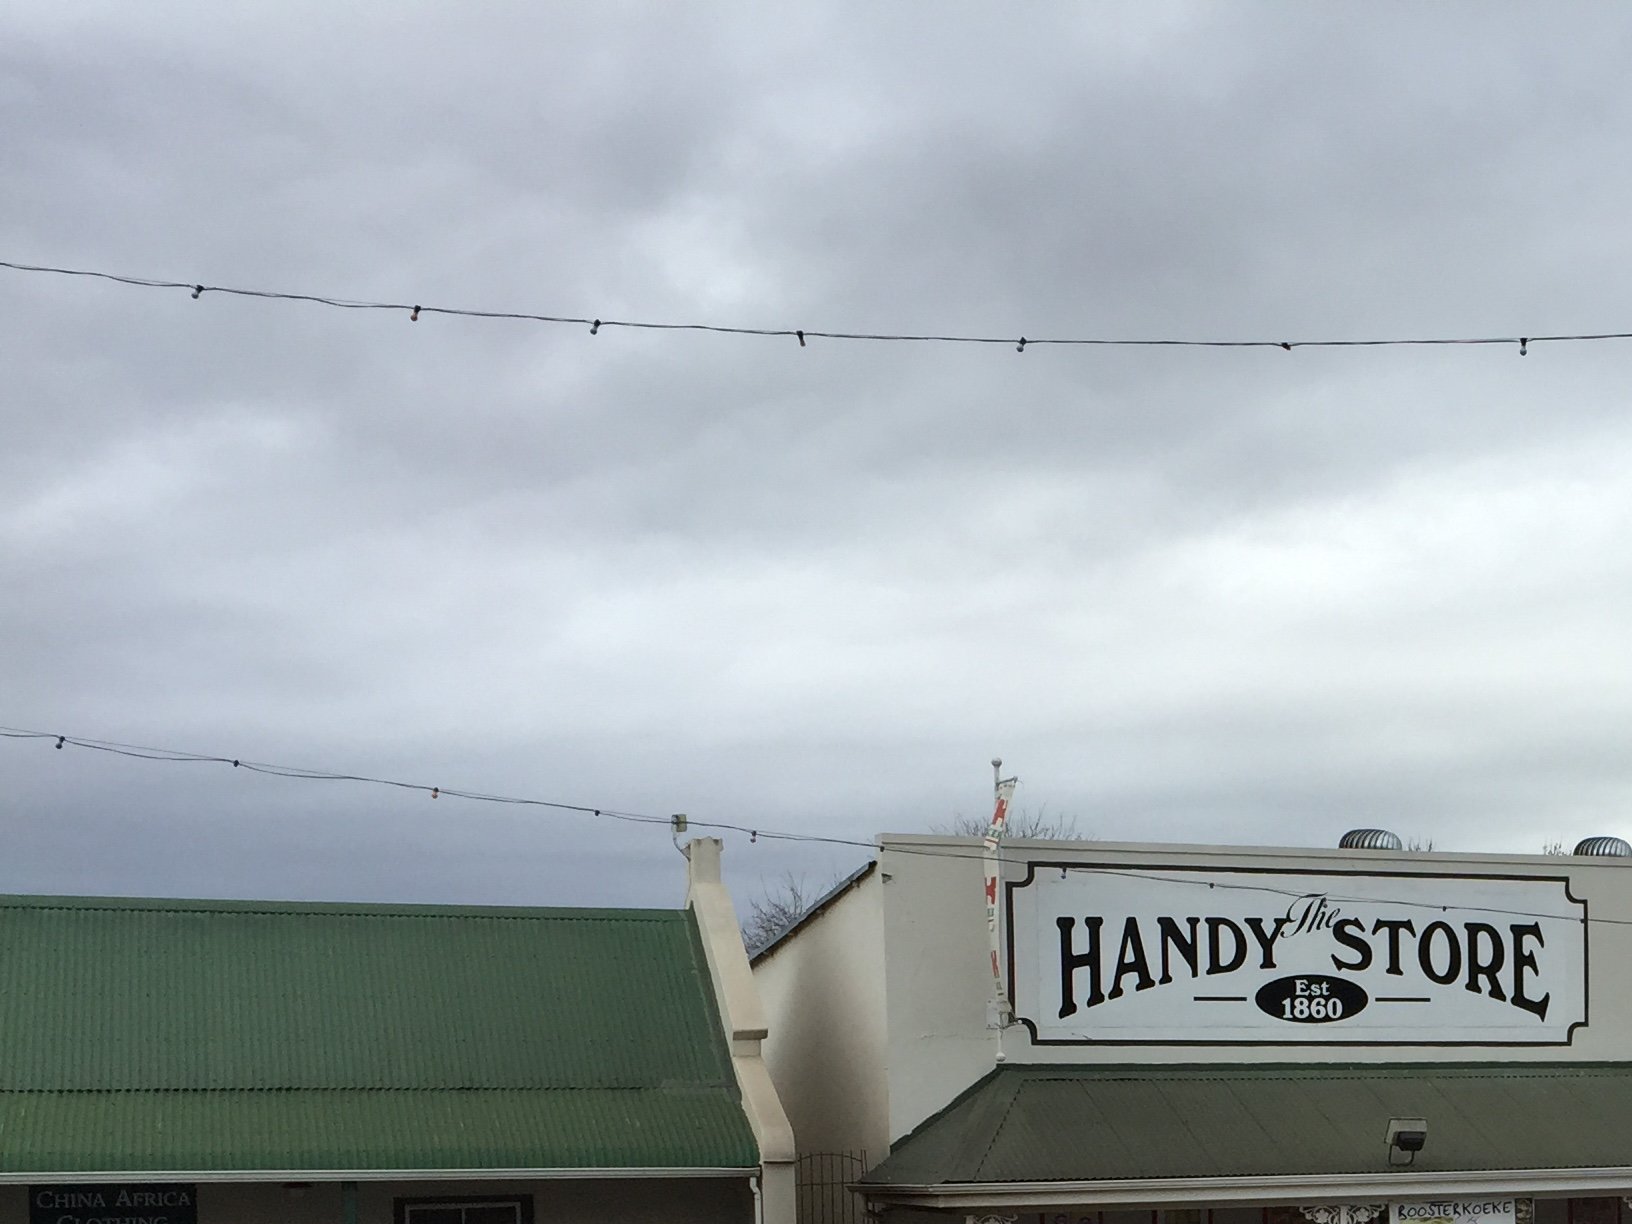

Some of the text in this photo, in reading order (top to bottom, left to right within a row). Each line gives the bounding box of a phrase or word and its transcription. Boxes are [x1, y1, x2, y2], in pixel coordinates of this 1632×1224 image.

[1280, 892, 1341, 938] The
[1056, 916, 1551, 1023] HANDY STORE
[1294, 979, 1330, 996] Est
[1281, 998, 1343, 1019] 1860
[36, 1189, 191, 1208] CHINA AFRICA
[1398, 1201, 1512, 1219] ROOSTERKOEKE
